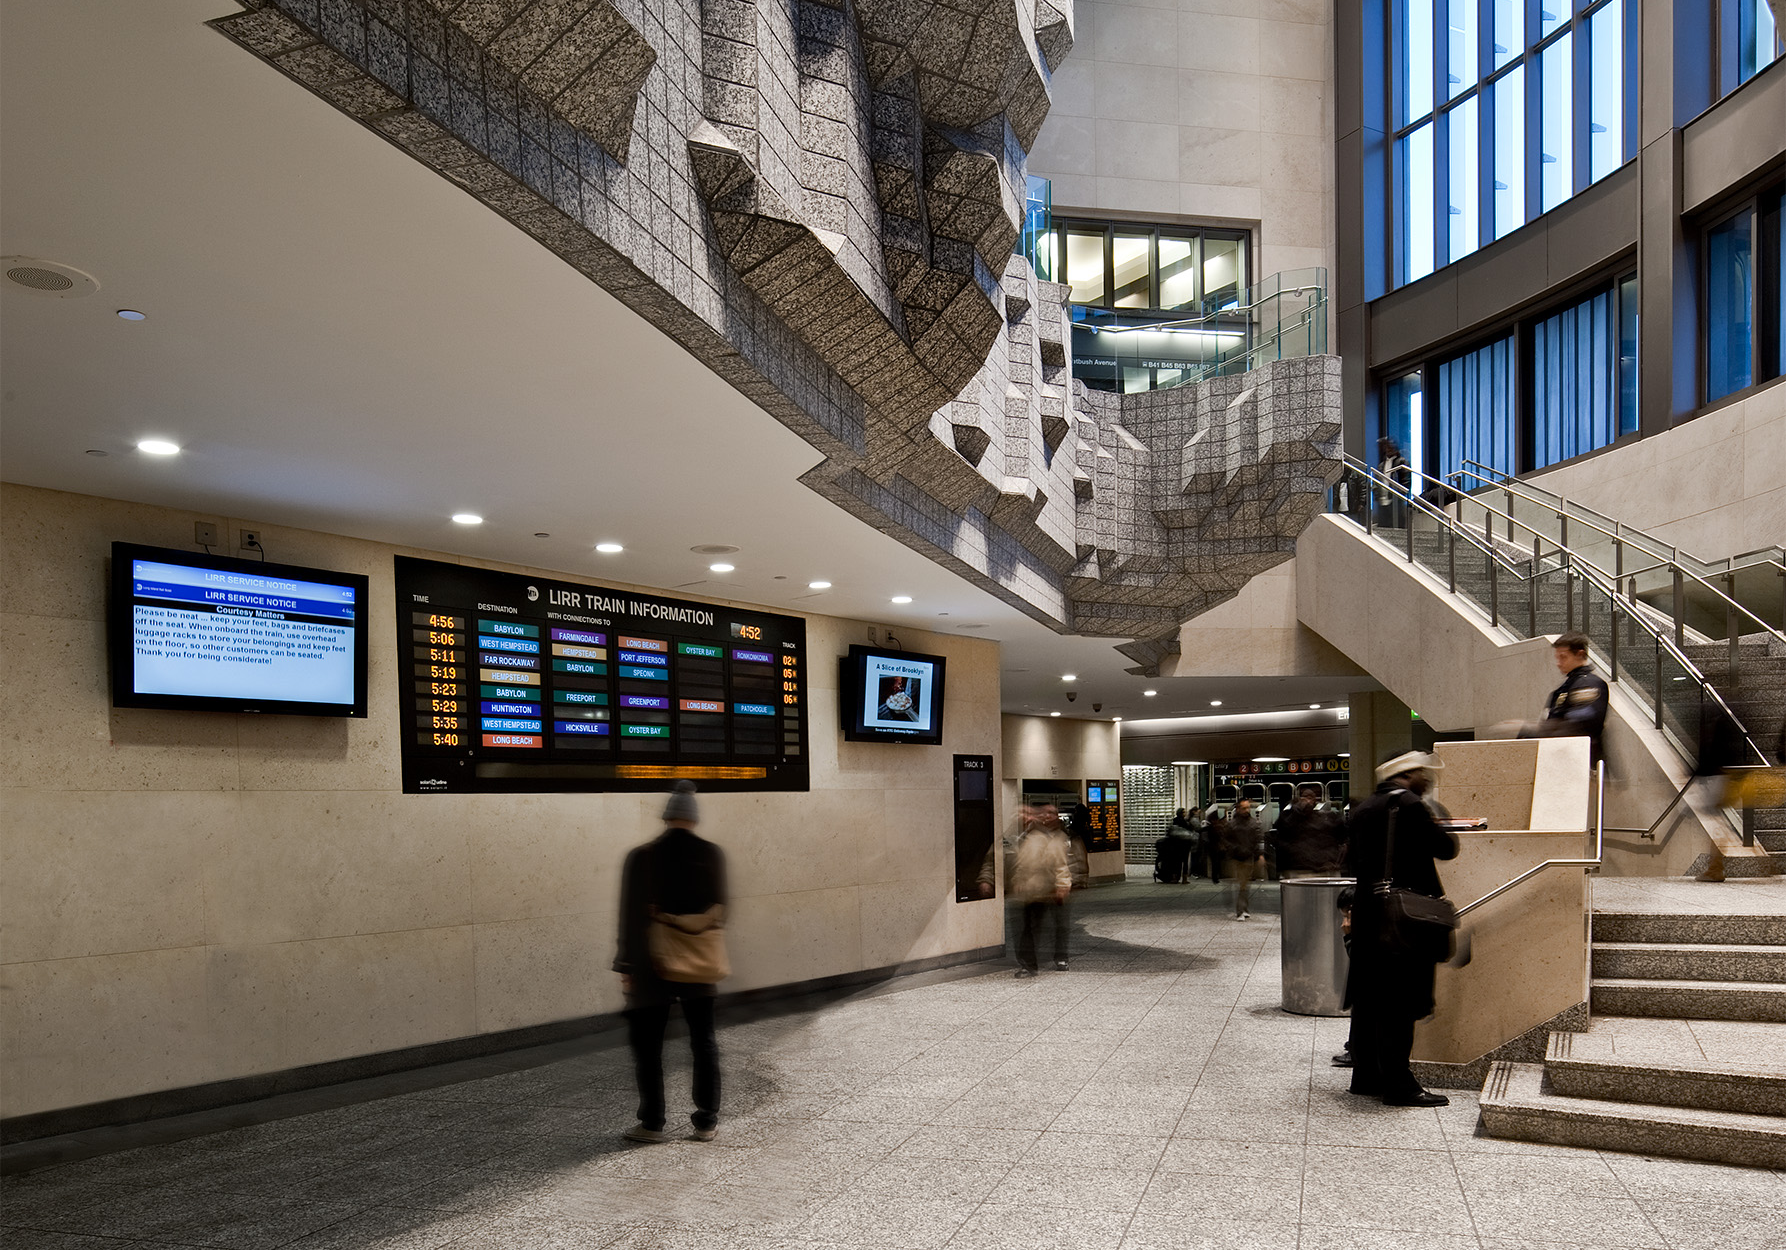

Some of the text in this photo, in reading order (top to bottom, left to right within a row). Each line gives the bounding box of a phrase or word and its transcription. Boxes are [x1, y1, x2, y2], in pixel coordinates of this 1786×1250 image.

[205, 573, 297, 591] LIRR SERVICE NOTICE
[205, 591, 297, 609] LIRR SERVICE NOTICE
[413, 594, 429, 603] TIME
[216, 605, 285, 620] Courtesy Matters
[477, 602, 518, 614] DESTINATION
[549, 589, 714, 626] LIRR TRAIN INFORMATION
[135, 607, 164, 616] Please
[210, 615, 230, 623] keep
[232, 618, 250, 626] your
[271, 621, 290, 630] bags
[292, 623, 306, 631] and
[307, 624, 346, 635] briefcases
[429, 614, 455, 629] 4:56
[547, 611, 562, 620] WITH
[562, 613, 602, 626] CONNECTIONS
[166, 621, 187, 629] seat.
[188, 622, 213, 631] When
[214, 625, 249, 634] onboard
[250, 628, 264, 636] the
[302, 633, 337, 643] overhead
[494, 624, 524, 635] BABYLON
[740, 625, 761, 640] 4:52
[135, 628, 170, 638] luggage
[172, 631, 197, 640] racks
[252, 637, 295, 649] belongings
[312, 643, 330, 652] keep
[332, 645, 346, 653] feet
[430, 631, 455, 646] 5:06
[558, 632, 600, 644] FARMINGDALE
[149, 638, 163, 646] the
[165, 640, 188, 649] floor,
[202, 642, 224, 651] other
[226, 646, 269, 655] customers
[297, 651, 325, 660] seated.
[480, 639, 538, 652] WEST HEMPSTEAD
[626, 639, 660, 650] LONG BEACH
[135, 647, 273, 664] Thank you for being considerate!
[430, 648, 456, 662] 5:11
[562, 648, 597, 658] HEMPSTEAD
[685, 646, 715, 656] OYSTER BAY
[736, 651, 769, 662] RONKONKOMA
[484, 655, 535, 667] FAR ROCKAWAY
[620, 653, 666, 665] PORT JEFFERSON
[782, 655, 792, 666] 02
[431, 666, 456, 679] 5:19
[566, 663, 594, 673] BABYLON
[633, 669, 655, 678] SPEONK
[783, 668, 793, 678] 05
[881, 664, 894, 672] Slice
[902, 666, 924, 676] Brooklyn
[491, 672, 530, 682] HEMPSTEAD
[431, 682, 457, 696] 5:23
[783, 681, 793, 692] 01
[496, 688, 527, 698] BABYLON
[566, 693, 596, 703] FREEPORT
[783, 694, 793, 704] 06
[432, 699, 458, 713] 5:29
[628, 697, 660, 706] GREENPORT
[686, 701, 718, 710] LONG BEACH
[491, 704, 532, 714] HUNTINGTON
[740, 705, 768, 713] PATCHOGUE
[432, 716, 458, 729] 5:35
[483, 719, 540, 730] WEST HEMPSTEAD
[565, 723, 599, 733] HICKSVILLE
[628, 726, 662, 735] OYSTER BAY
[433, 733, 459, 746] 5:40
[492, 736, 533, 745] LONG BEACH
[963, 760, 979, 768] TRACK
